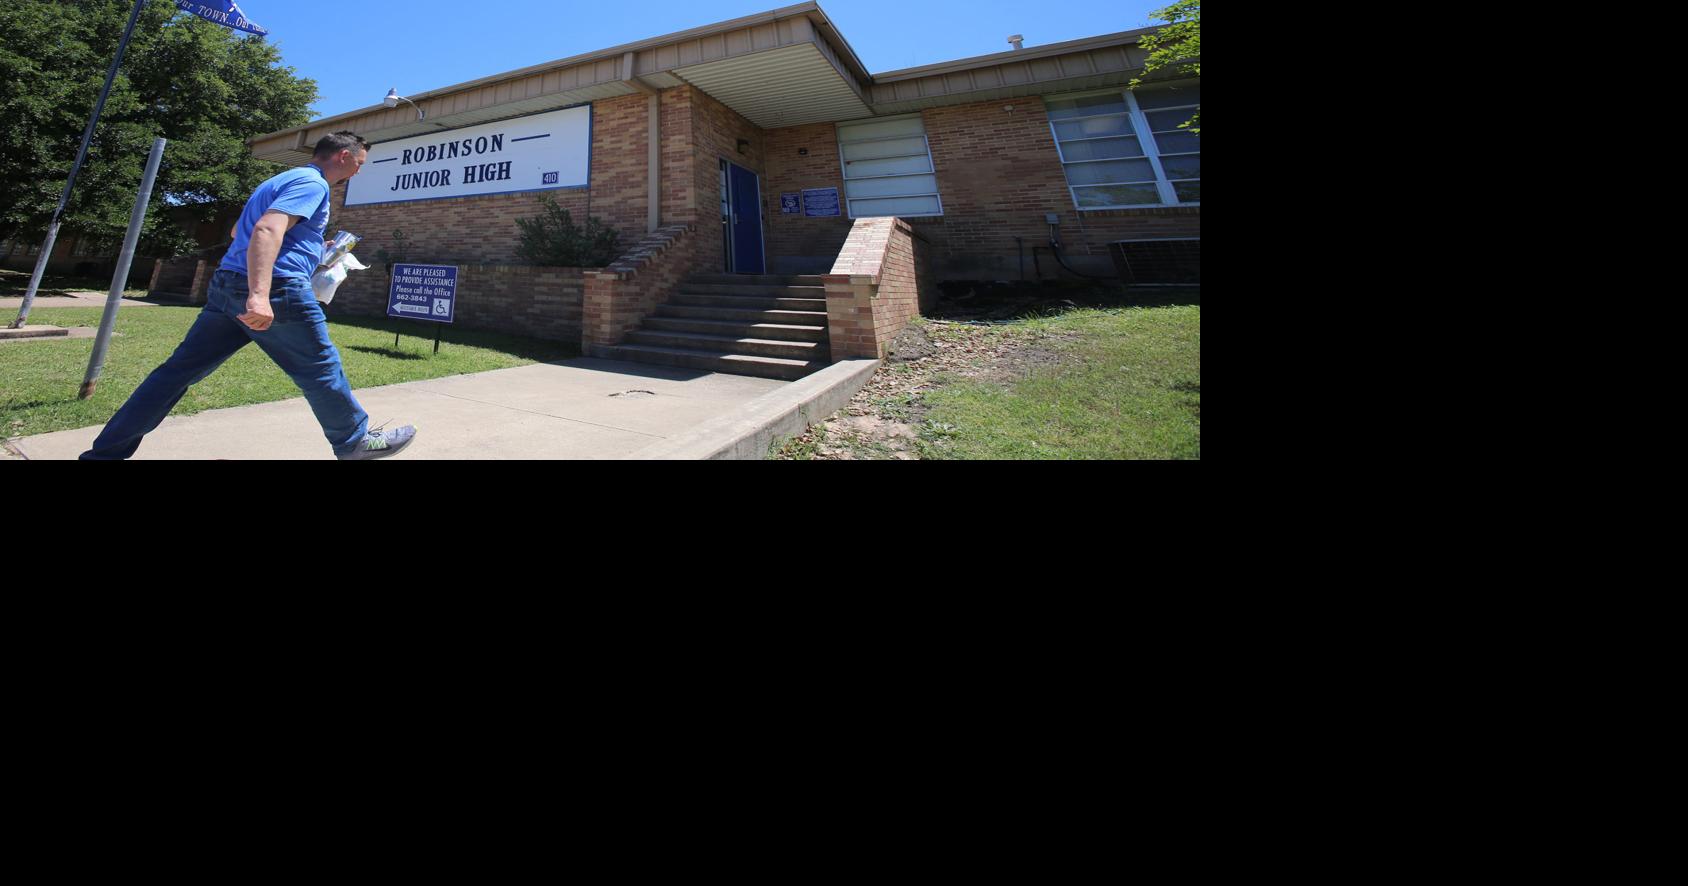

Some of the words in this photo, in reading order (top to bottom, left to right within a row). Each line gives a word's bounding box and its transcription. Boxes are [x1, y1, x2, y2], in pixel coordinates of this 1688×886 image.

[401, 133, 504, 166] ROBINSON
[390, 169, 451, 192] JUNIOR
[462, 161, 513, 184] HIGH
[543, 172, 557, 183] 410
[403, 267, 411, 275] WE
[412, 268, 422, 276] ARE
[423, 268, 446, 277] PLEASED
[394, 275, 401, 283] TO
[401, 276, 422, 284] PROVIDE
[423, 277, 455, 287] ASSISTANCE
[396, 285, 413, 293] Please
[413, 286, 423, 294] call
[424, 287, 432, 295] the
[433, 287, 451, 297] Office
[396, 294, 427, 302] 662-3843
